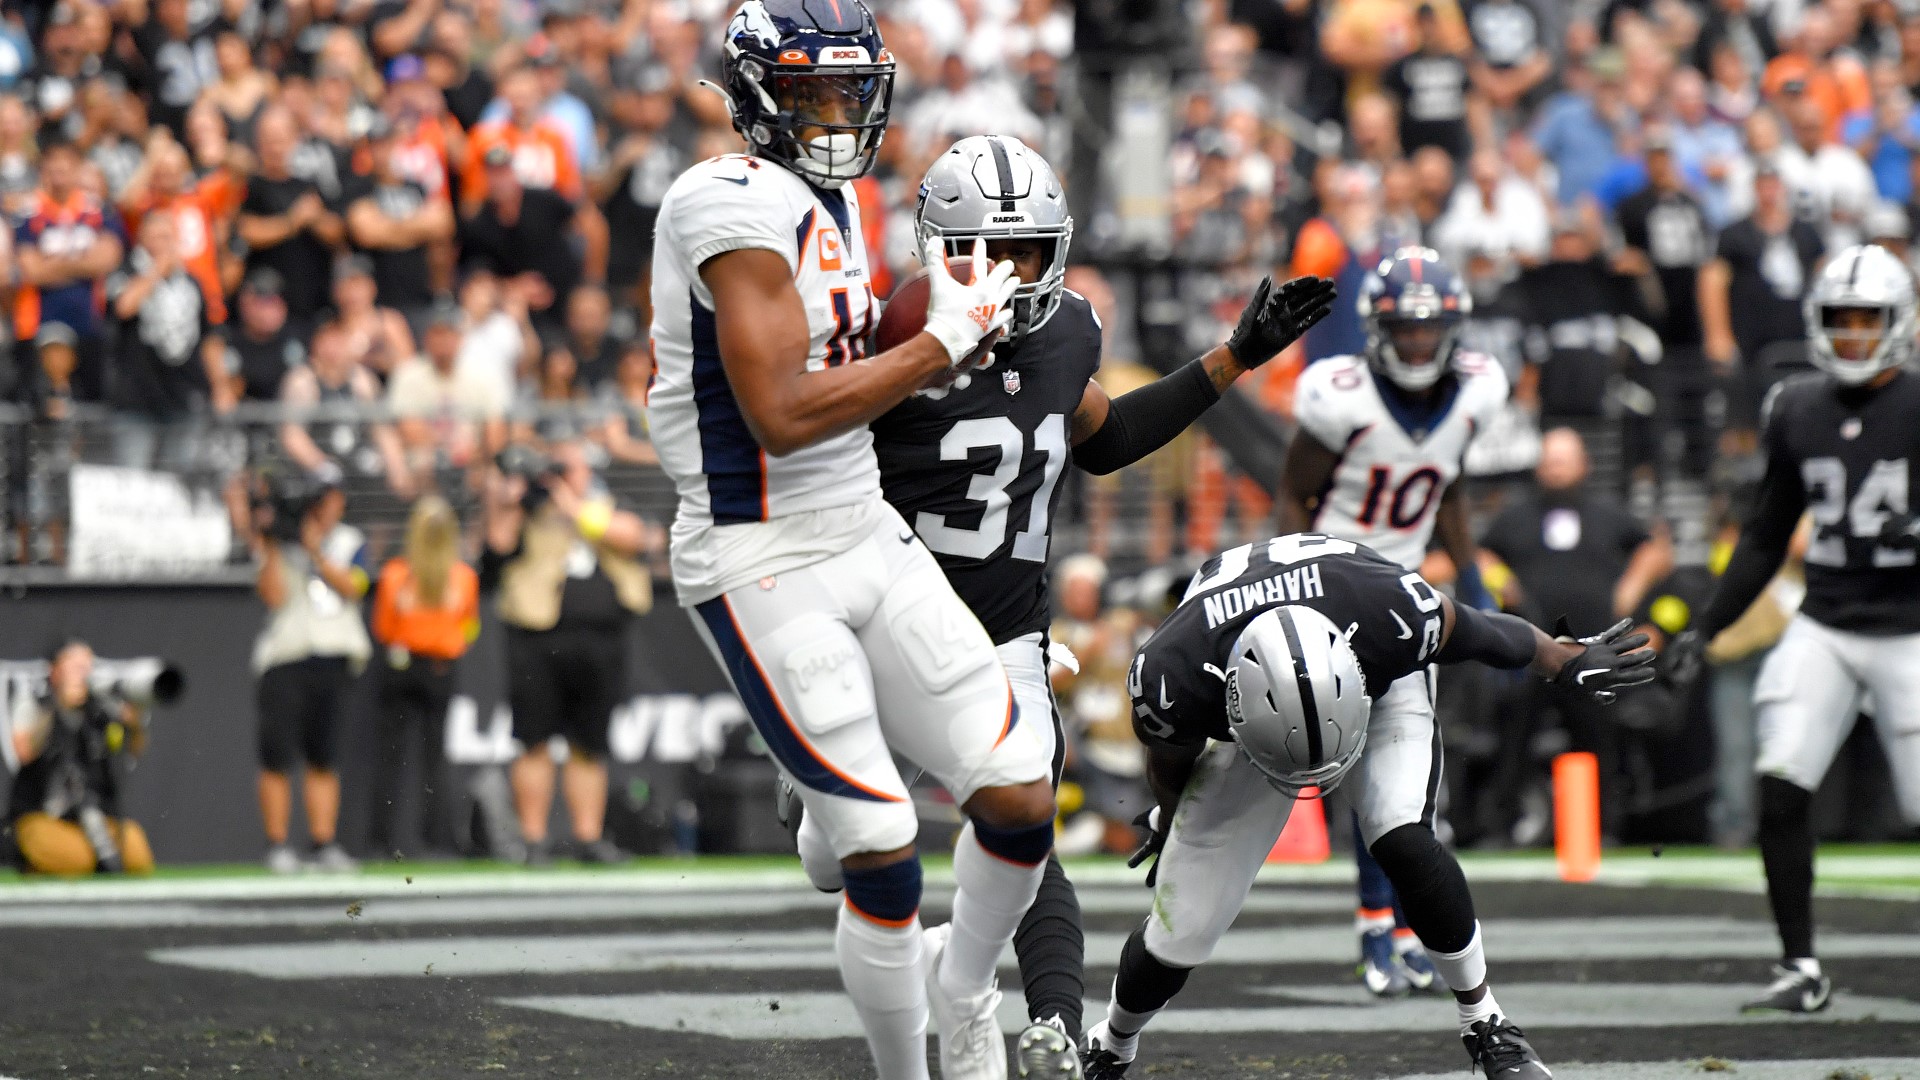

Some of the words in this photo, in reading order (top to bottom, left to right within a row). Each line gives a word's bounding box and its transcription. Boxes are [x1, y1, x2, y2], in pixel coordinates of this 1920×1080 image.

[821, 230, 840, 260] C
[915, 414, 1067, 563] 31
[1357, 465, 1442, 533] 10
[1801, 456, 1916, 568] 24
[1203, 563, 1325, 630] HARMON
[907, 602, 980, 672] 14
